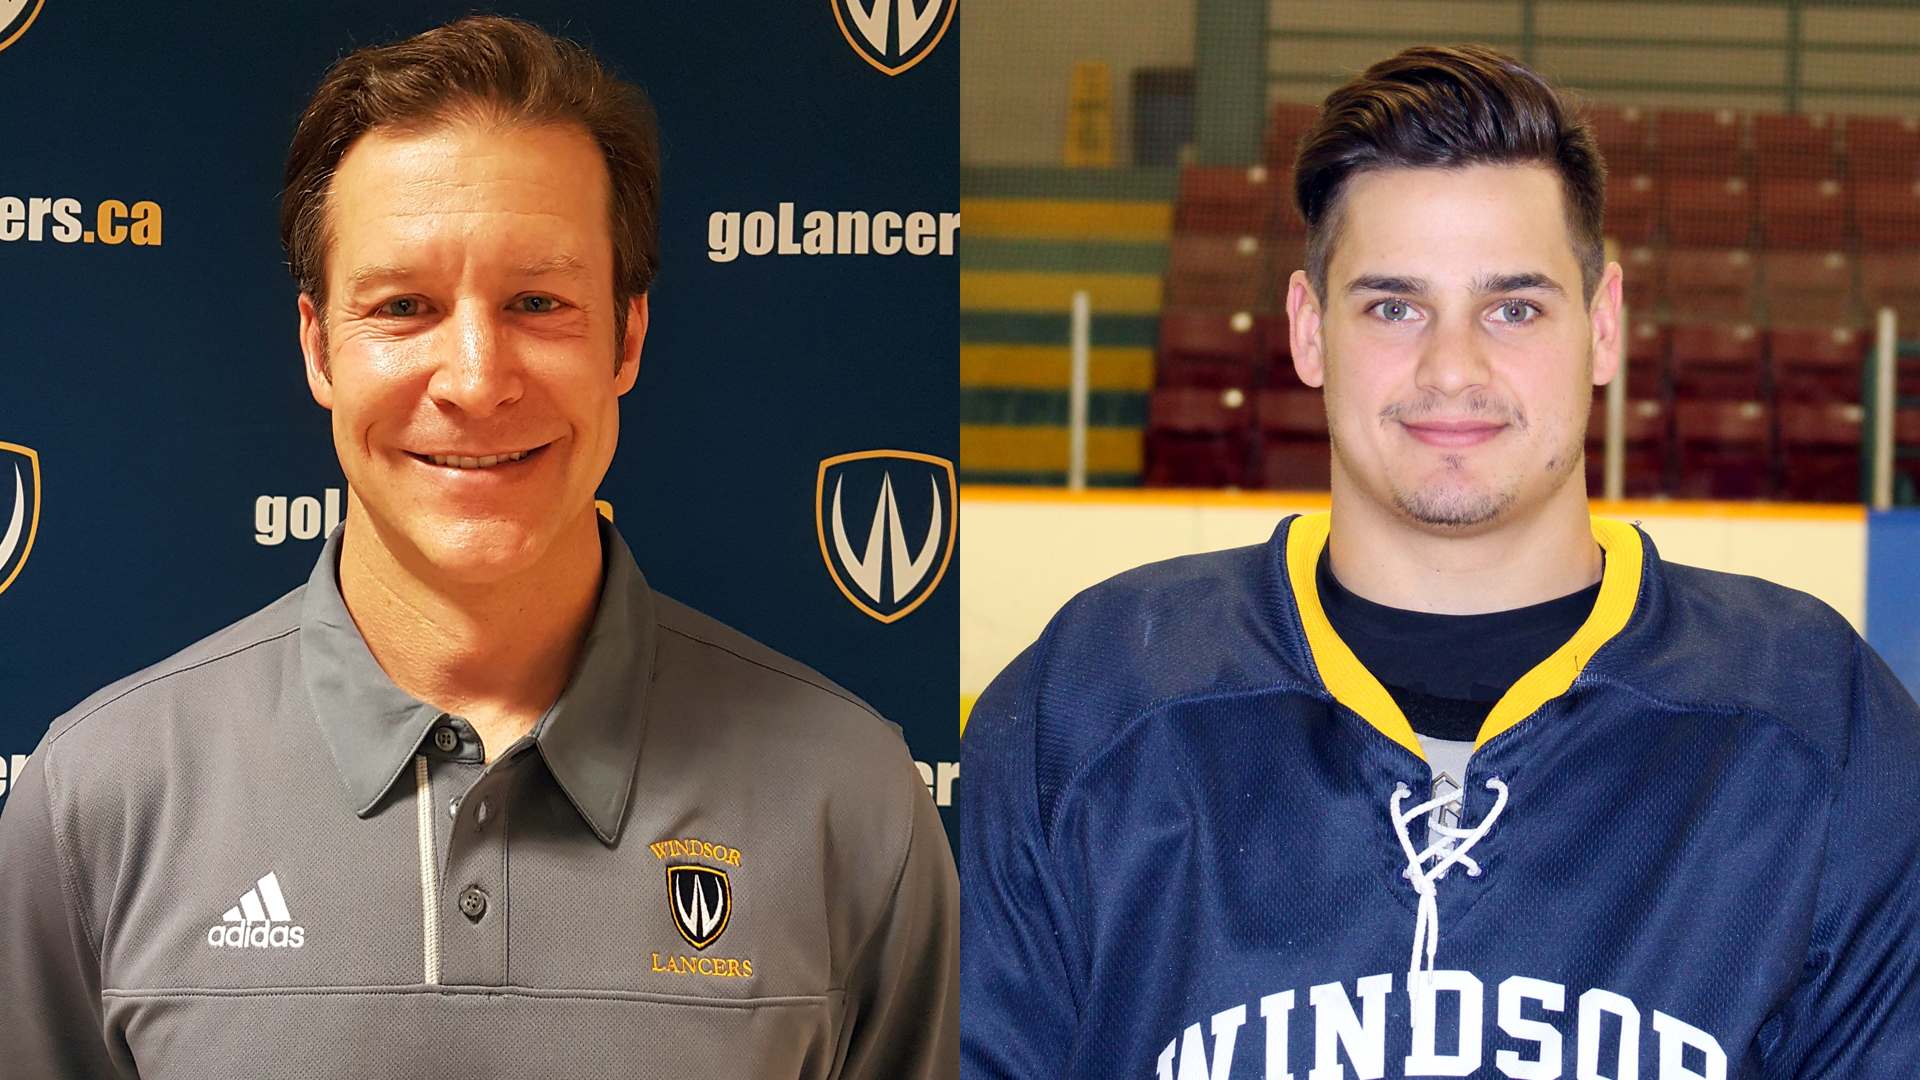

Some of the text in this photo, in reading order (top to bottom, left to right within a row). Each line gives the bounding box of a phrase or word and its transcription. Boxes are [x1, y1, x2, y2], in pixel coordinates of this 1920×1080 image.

[708, 202, 960, 263] goLancer
[649, 838, 742, 867] WINDSOR
[207, 918, 305, 949] adidas
[652, 953, 753, 977] LANCERS
[1156, 970, 1728, 1080] WINDSOR
